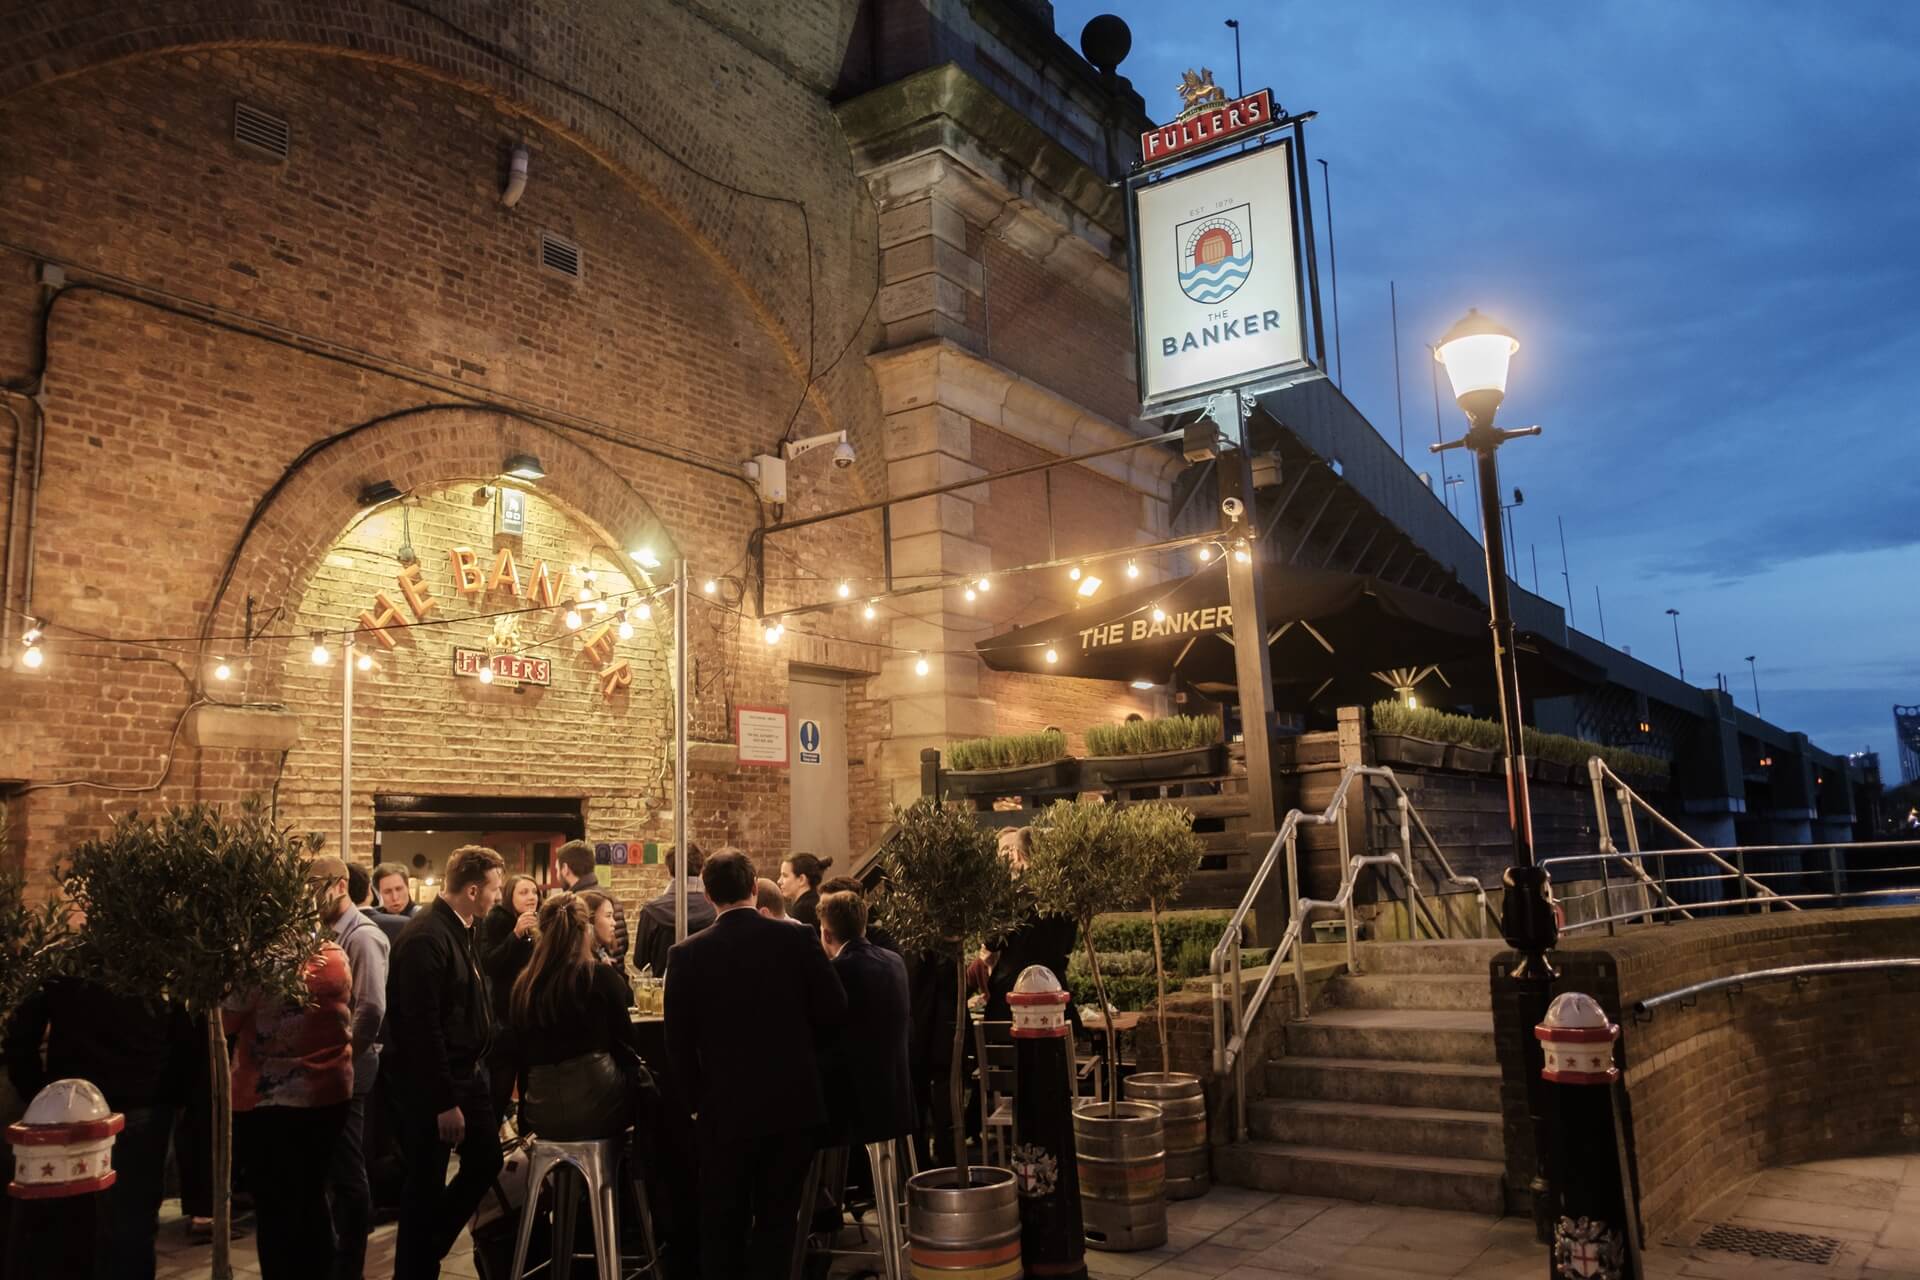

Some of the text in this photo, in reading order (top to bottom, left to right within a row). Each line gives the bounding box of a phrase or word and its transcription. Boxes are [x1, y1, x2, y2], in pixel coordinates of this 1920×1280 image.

[1148, 102, 1260, 156] FULLER'S
[1162, 310, 1281, 356] BANKER
[1208, 309, 1229, 321] THE
[450, 546, 632, 703] BANER
[1079, 605, 1233, 649] THE BANKER
